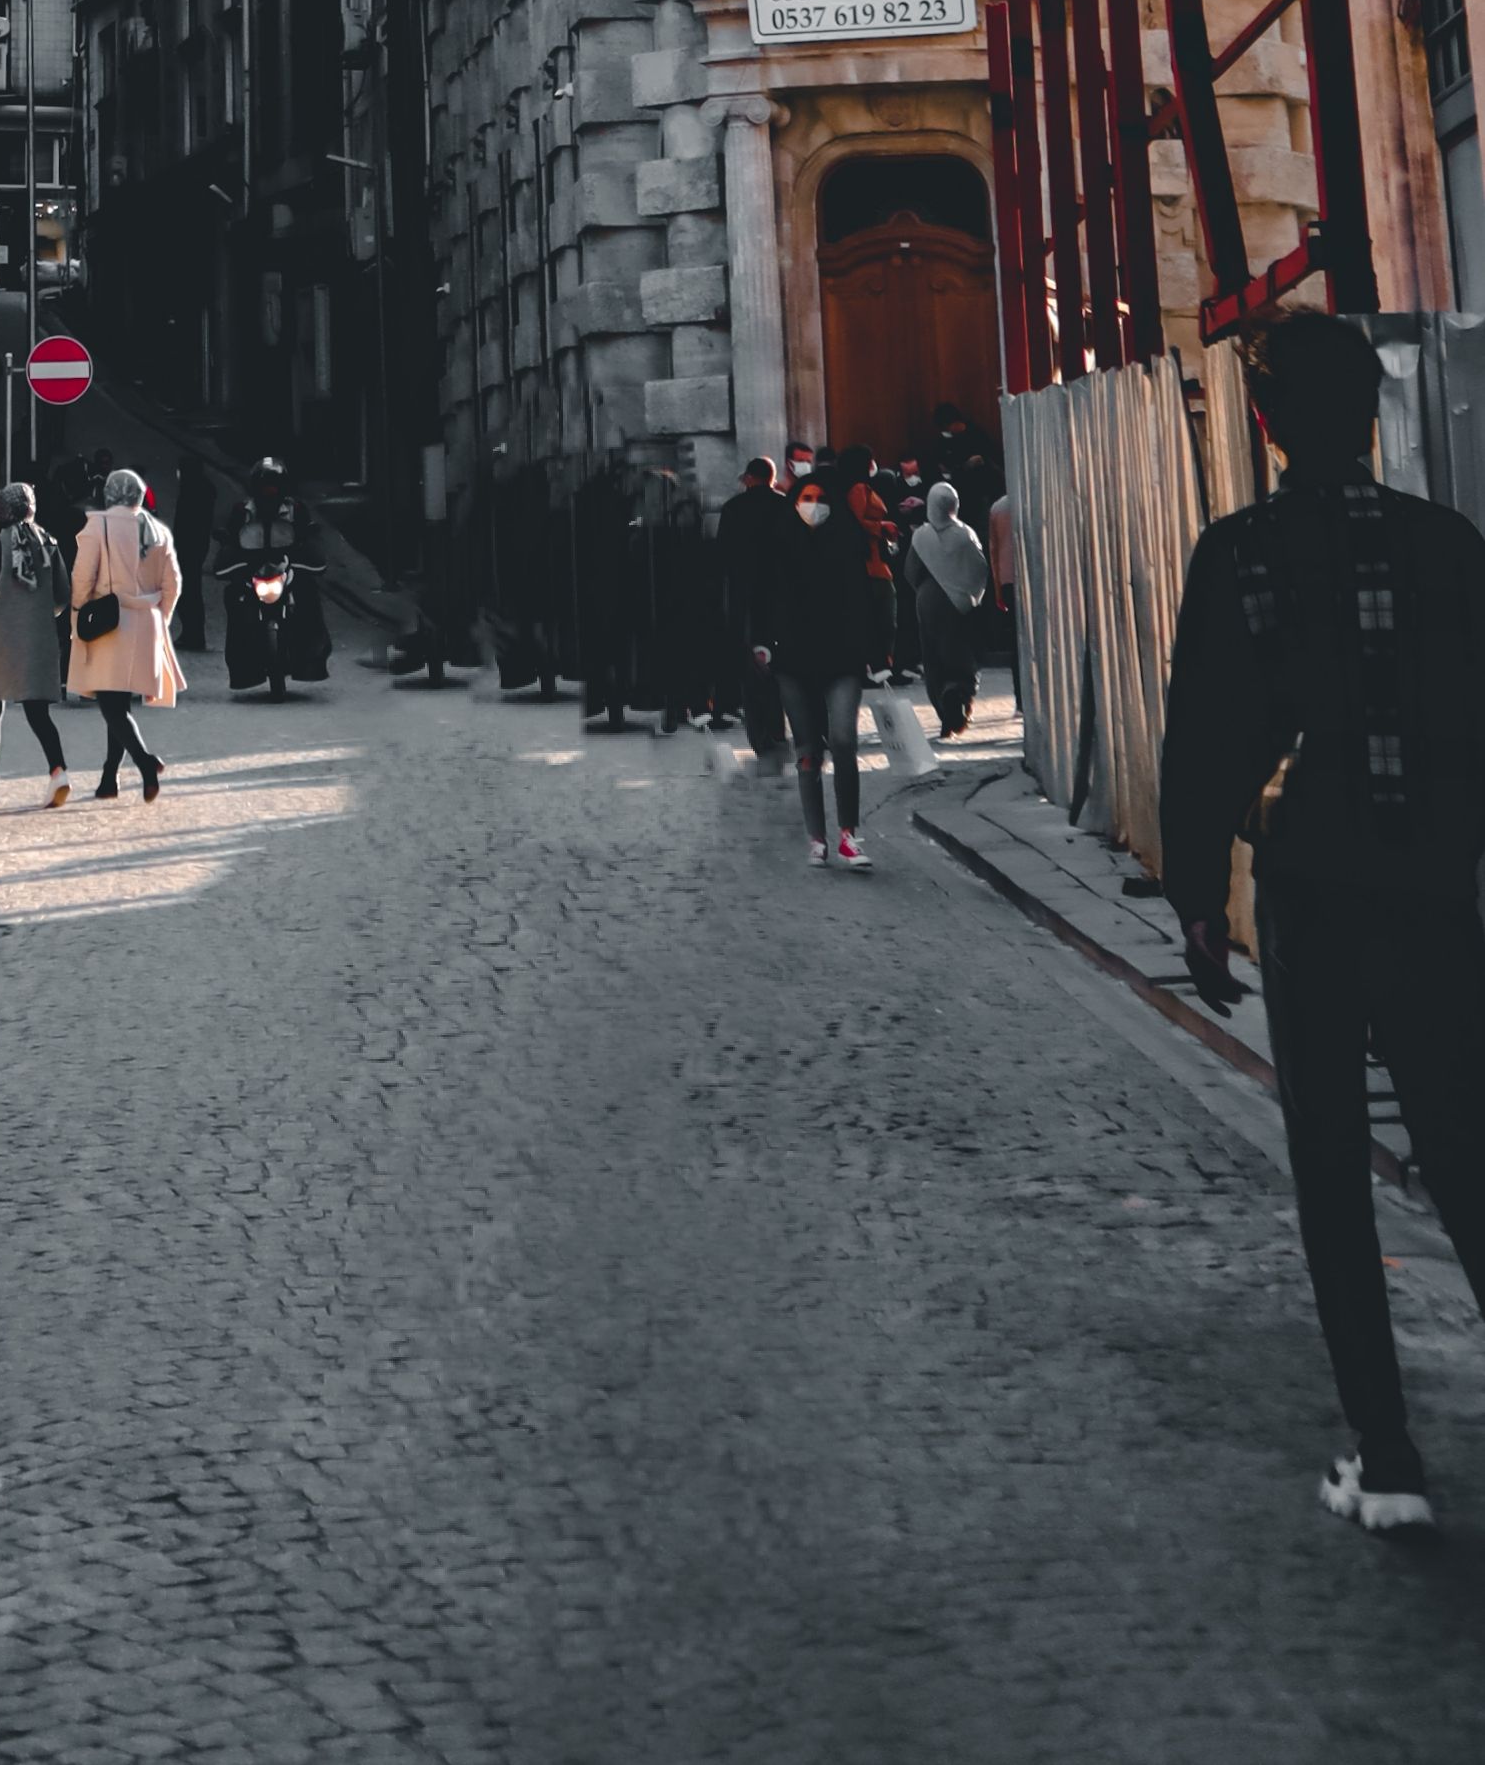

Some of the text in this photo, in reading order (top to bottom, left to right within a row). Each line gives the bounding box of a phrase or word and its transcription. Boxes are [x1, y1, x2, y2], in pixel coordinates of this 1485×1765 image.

[772, 0, 947, 30] 0537 619 82 23
